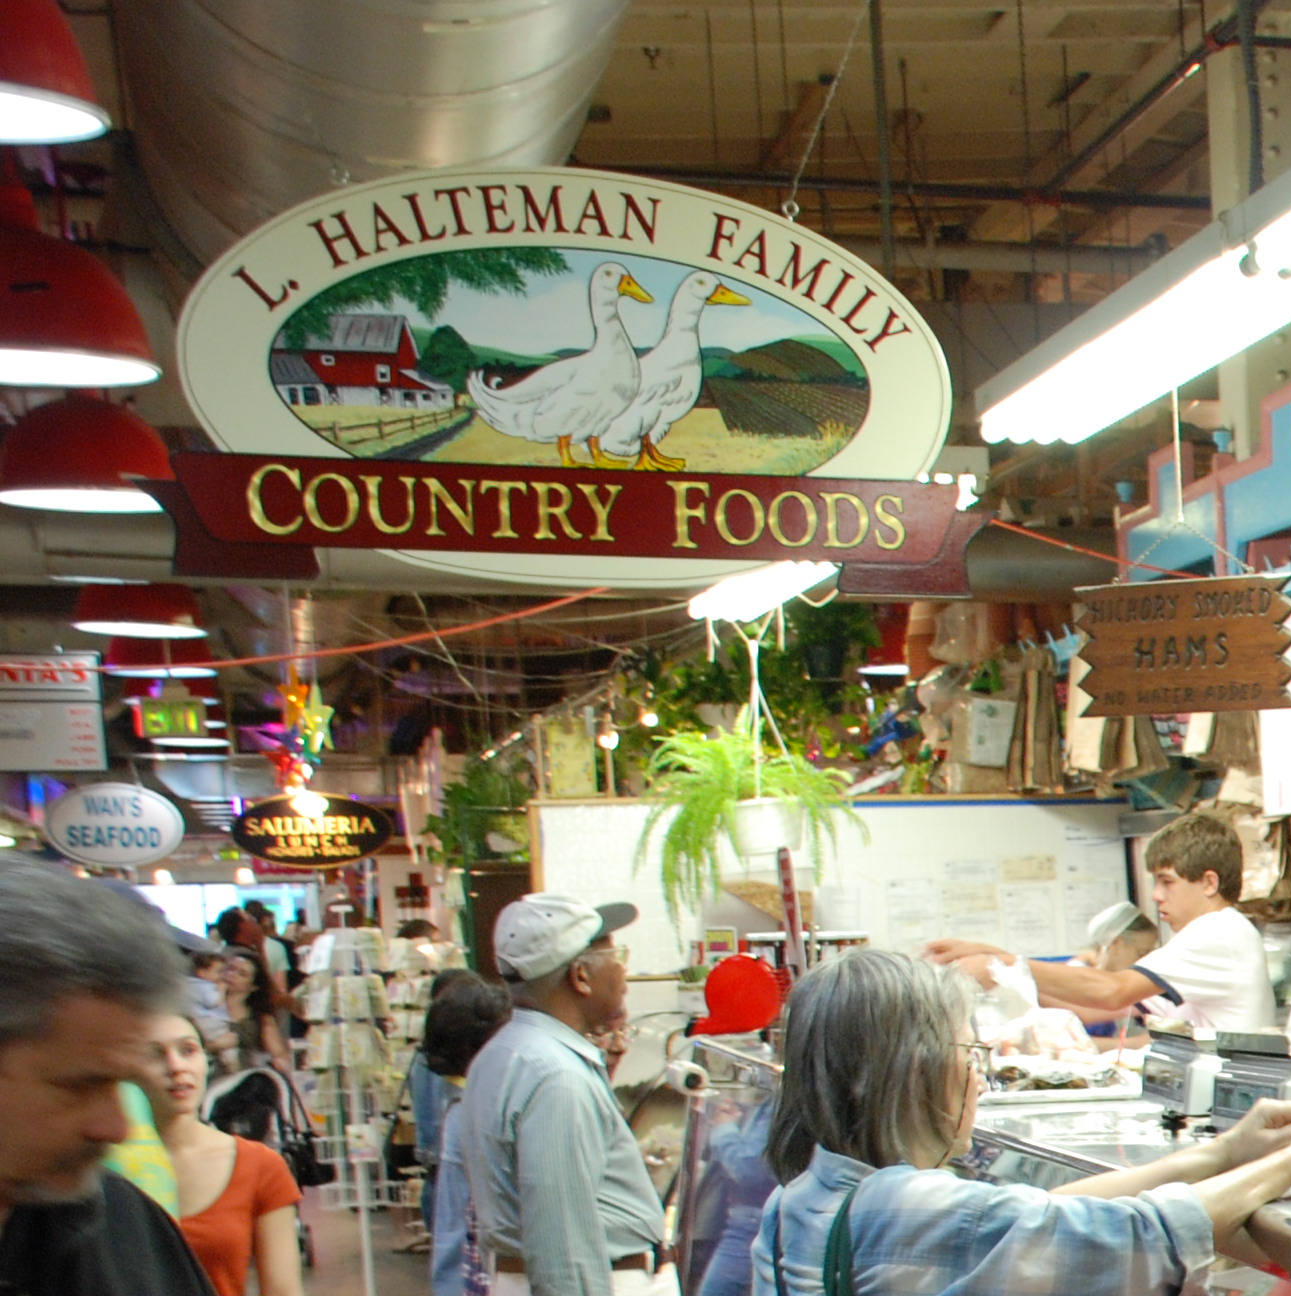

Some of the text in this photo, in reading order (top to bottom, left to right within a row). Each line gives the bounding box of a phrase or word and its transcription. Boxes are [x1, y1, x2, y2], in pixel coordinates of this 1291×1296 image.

[231, 183, 914, 356] L. HALTEMAN FAMILY
[245, 462, 909, 552] COUNTRY FOODS
[1086, 587, 1273, 624] HICKORY SMOKED
[1133, 632, 1230, 672] HAMS
[1104, 681, 1263, 706] NO WATER ADDED
[83, 795, 143, 817] WAN'S
[65, 825, 162, 849] SEAFOOD
[244, 815, 376, 837] SALUMERIA
[276, 836, 348, 848] LUNCH
